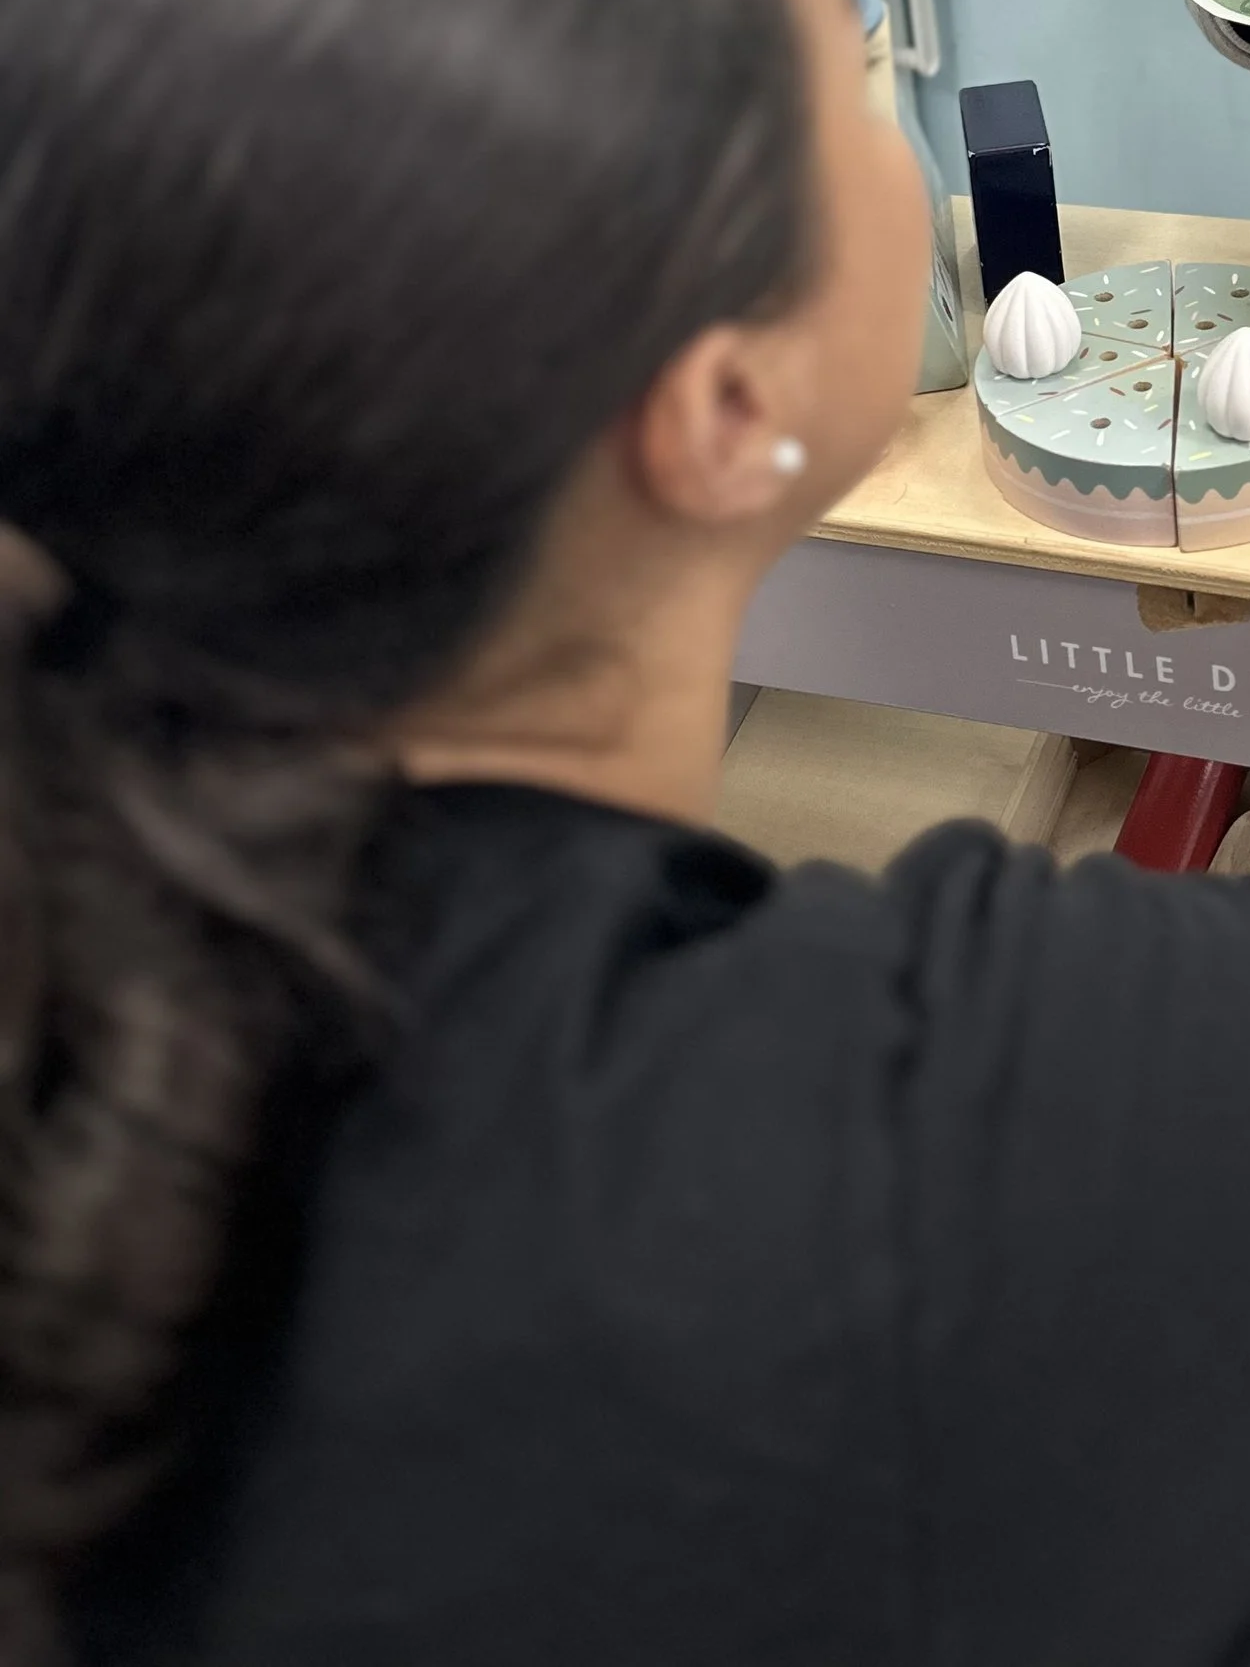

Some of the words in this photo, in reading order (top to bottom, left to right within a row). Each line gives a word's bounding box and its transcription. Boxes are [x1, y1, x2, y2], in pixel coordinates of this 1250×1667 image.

[1010, 634, 1175, 684] LITTLE
[1071, 683, 1134, 709] enjoy
[1138, 690, 1173, 707] the
[1182, 696, 1244, 718] little
